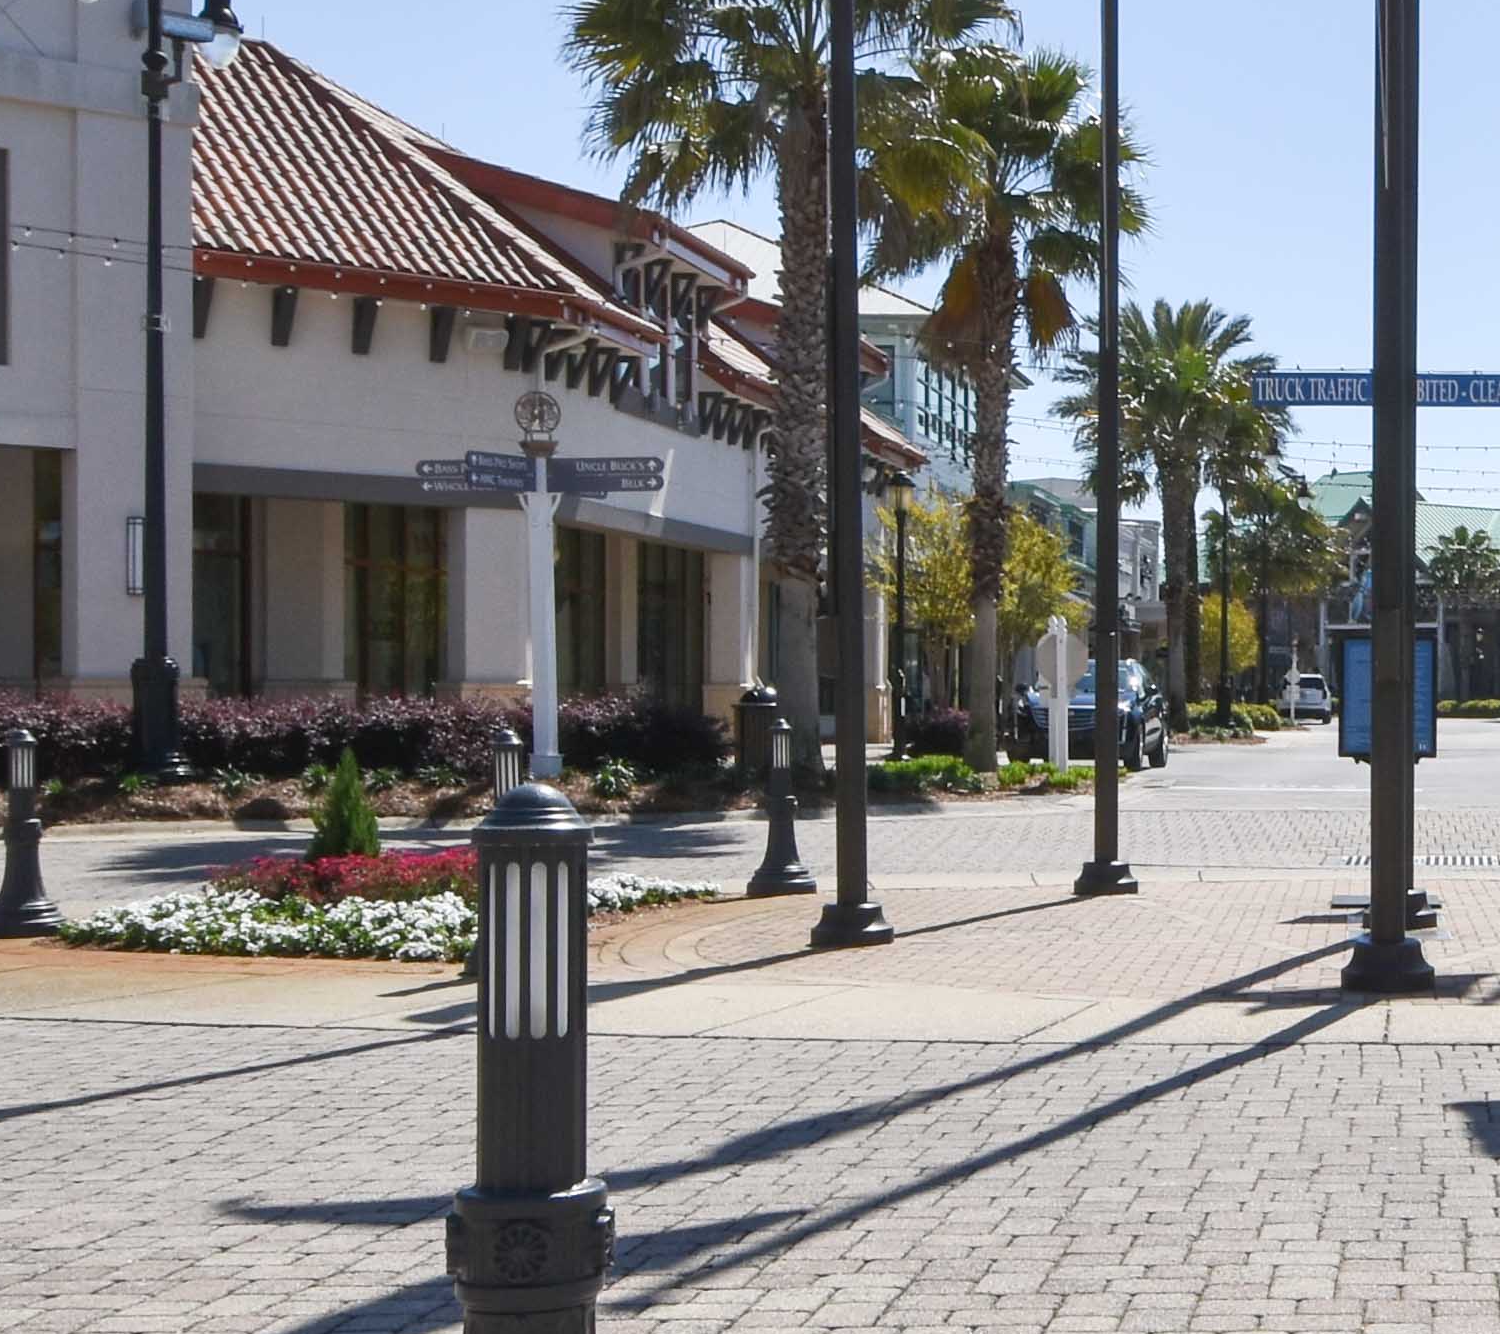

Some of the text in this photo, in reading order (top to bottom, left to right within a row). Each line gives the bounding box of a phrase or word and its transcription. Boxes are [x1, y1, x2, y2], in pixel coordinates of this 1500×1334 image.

[1255, 377, 1306, 402] TRUCK
[1307, 377, 1369, 402] TRAFFIC
[1415, 378, 1459, 403] BITED
